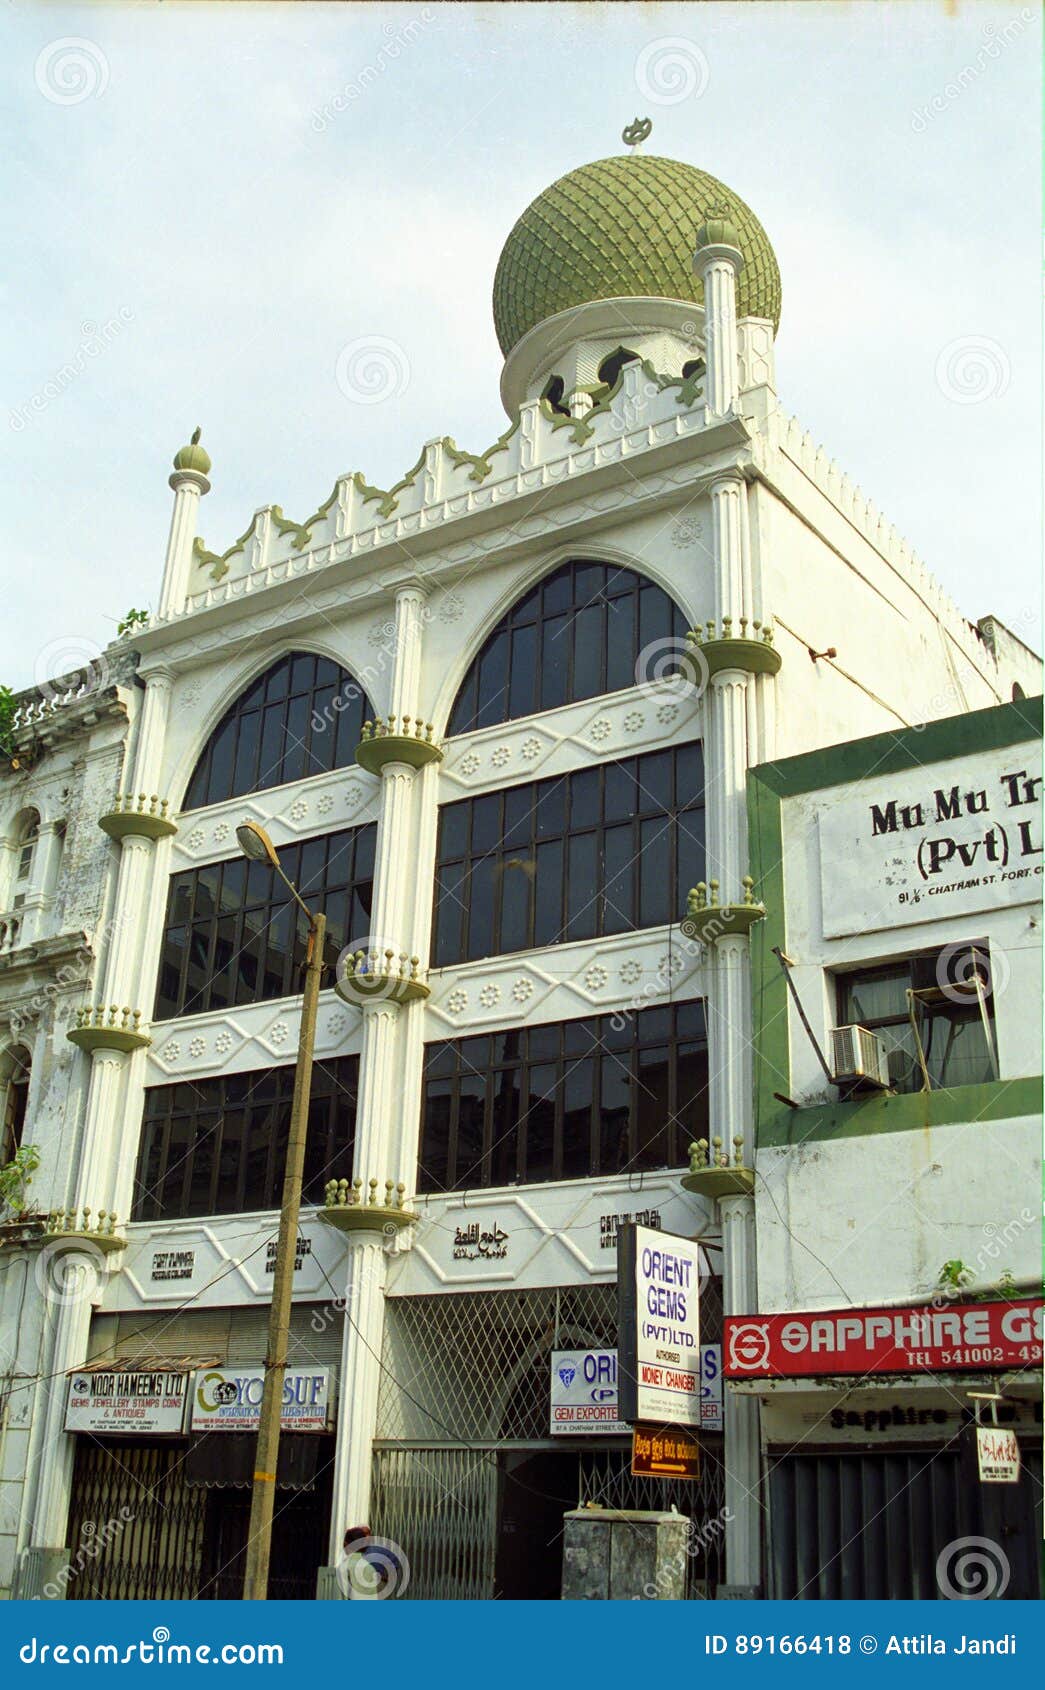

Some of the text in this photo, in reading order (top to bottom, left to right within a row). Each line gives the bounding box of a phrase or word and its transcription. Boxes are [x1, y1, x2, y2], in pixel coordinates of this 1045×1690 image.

[869, 800, 925, 837] Mu
[933, 786, 990, 823] Mu
[917, 822, 1009, 881] (Pvt)
[928, 879, 980, 896] CHATHAM
[642, 1247, 692, 1289] ORIENT
[647, 1284, 687, 1322] GEMS
[781, 1311, 990, 1353] SAPPHIRE
[583, 1354, 616, 1384] ORI
[655, 1348, 681, 1363] AUTHORISED
[906, 1352, 932, 1365] TEL
[942, 1348, 1003, 1364] 541002
[235, 1376, 325, 1405] YOSUF
[642, 1366, 696, 1391] MONEY CHANGER
[71, 1398, 182, 1408] GEMS JEWELLERY STAMPS COINS
[113, 1408, 146, 1418] ANTIQUES
[554, 1407, 574, 1420] GEM
